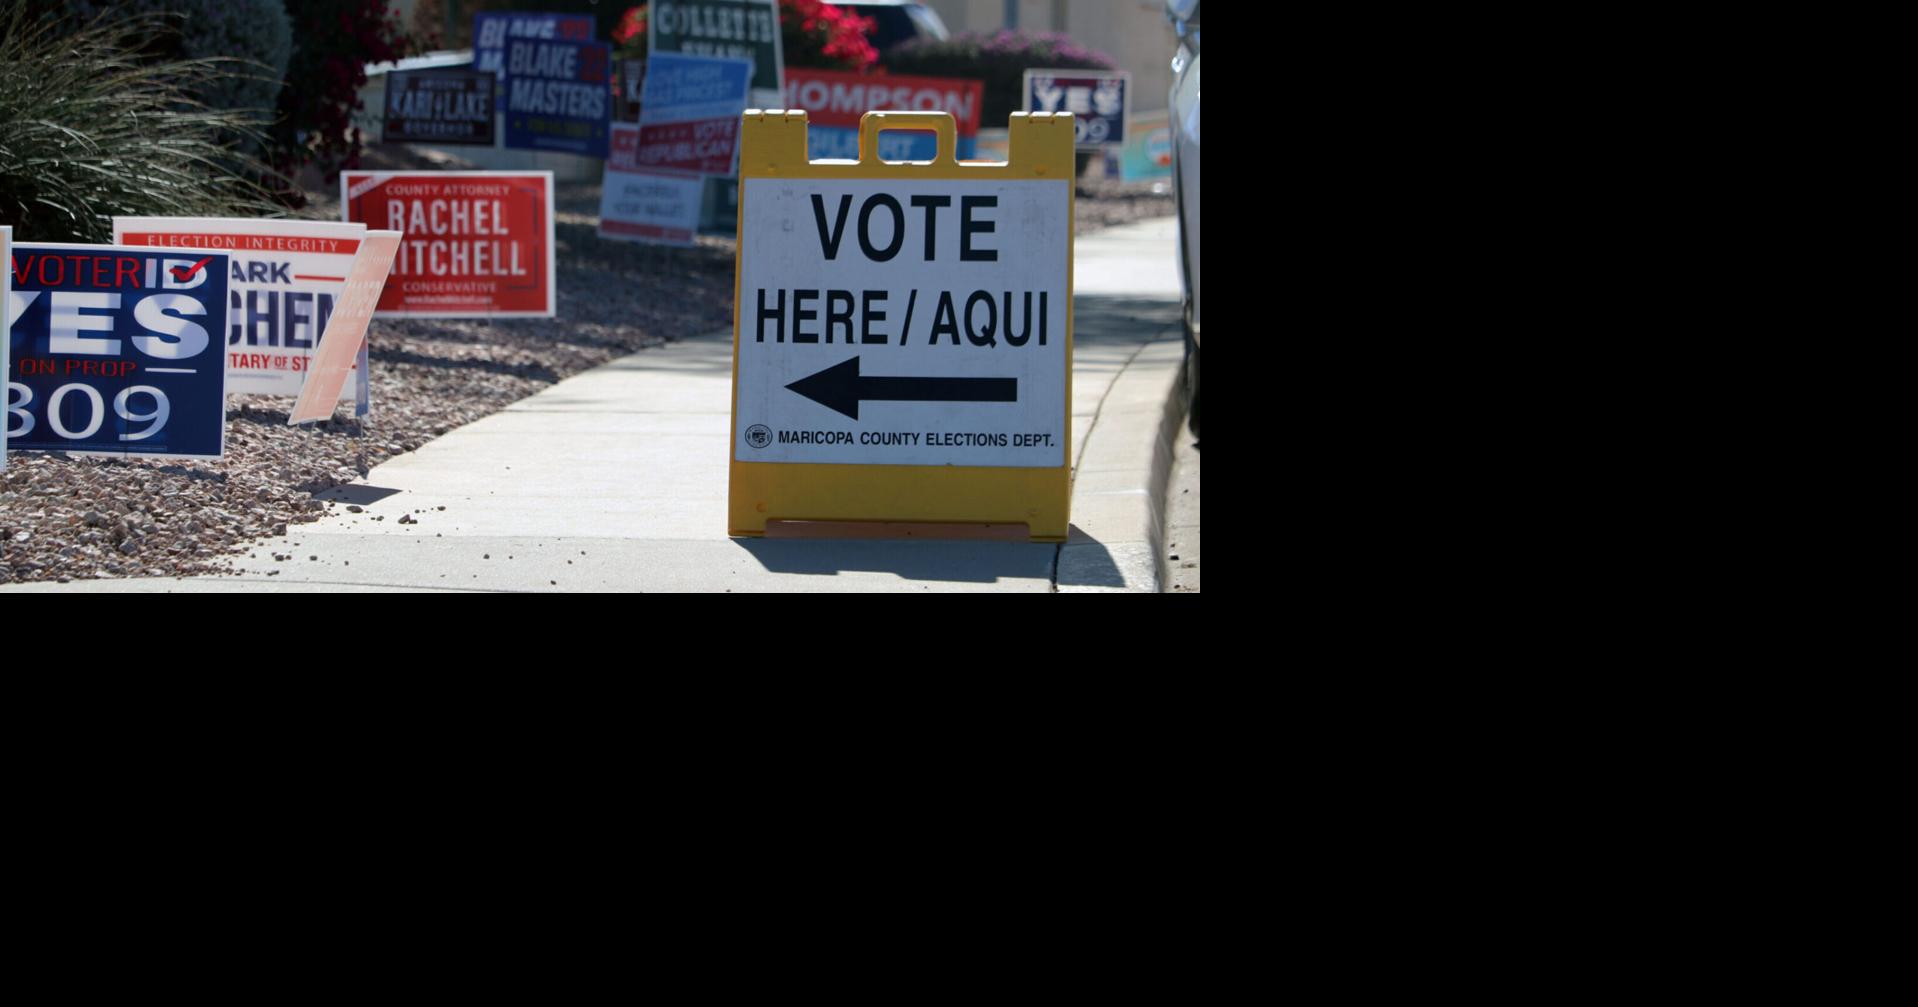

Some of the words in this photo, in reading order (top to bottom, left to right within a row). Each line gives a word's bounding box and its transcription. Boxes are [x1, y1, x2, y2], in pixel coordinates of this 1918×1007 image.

[509, 42, 577, 78] BLAKE
[389, 91, 432, 119] KARI
[444, 92, 489, 121] LAKE
[509, 78, 606, 119] MASTERS
[1034, 85, 1121, 116] YES
[693, 120, 734, 139] VOTE
[385, 184, 440, 196] COUNTY
[443, 184, 510, 197] ATTORNEY
[387, 199, 509, 236] RACHEL
[810, 193, 998, 262] VOTE
[147, 234, 241, 249] ELECTION
[245, 236, 339, 253] INTEGRITY
[402, 281, 497, 293] CONSERVATIVE
[756, 289, 888, 344] HERE
[928, 290, 1048, 349] AQUI
[19, 358, 55, 376] ON
[65, 359, 137, 377] PROP
[274, 357, 287, 367] OF
[778, 430, 854, 445] MARICOPA
[860, 432, 920, 446] COUNTY
[926, 433, 1007, 447] ELECTIONS
[1013, 433, 1054, 447] DEPT.
